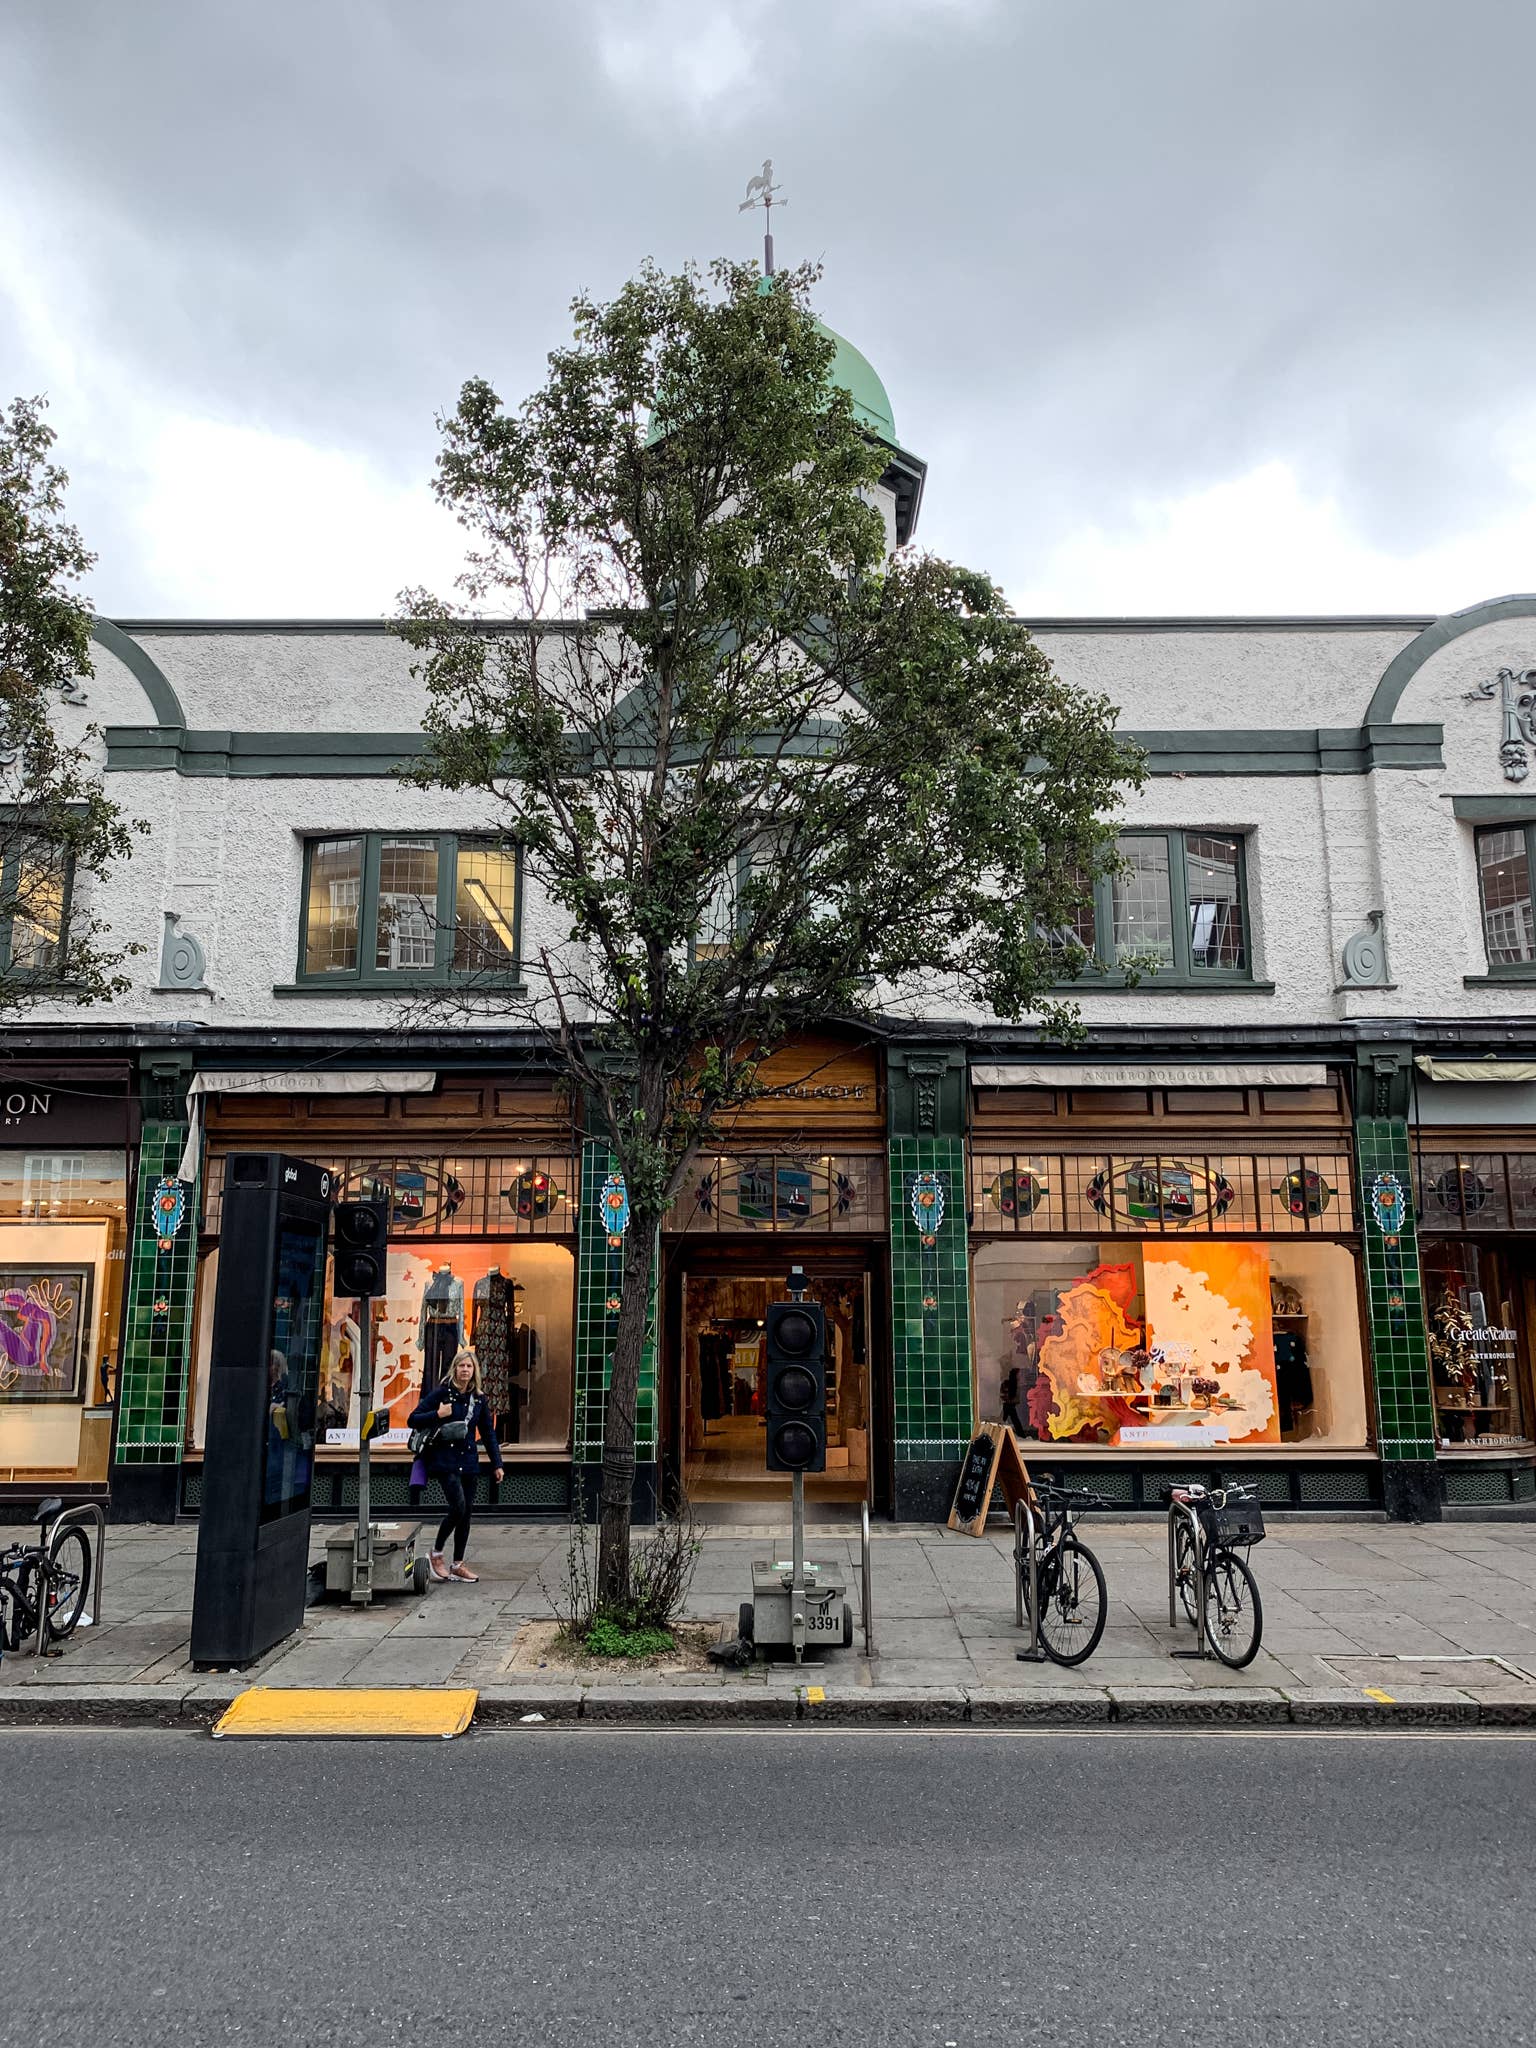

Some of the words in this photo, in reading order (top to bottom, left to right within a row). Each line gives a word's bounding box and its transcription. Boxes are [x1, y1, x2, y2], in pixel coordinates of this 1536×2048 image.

[1084, 1071, 1215, 1081] ANTHROPOLOGIE
[0, 1093, 52, 1114] ON
[819, 1602, 829, 1616] M
[807, 1616, 840, 1631] 3391
